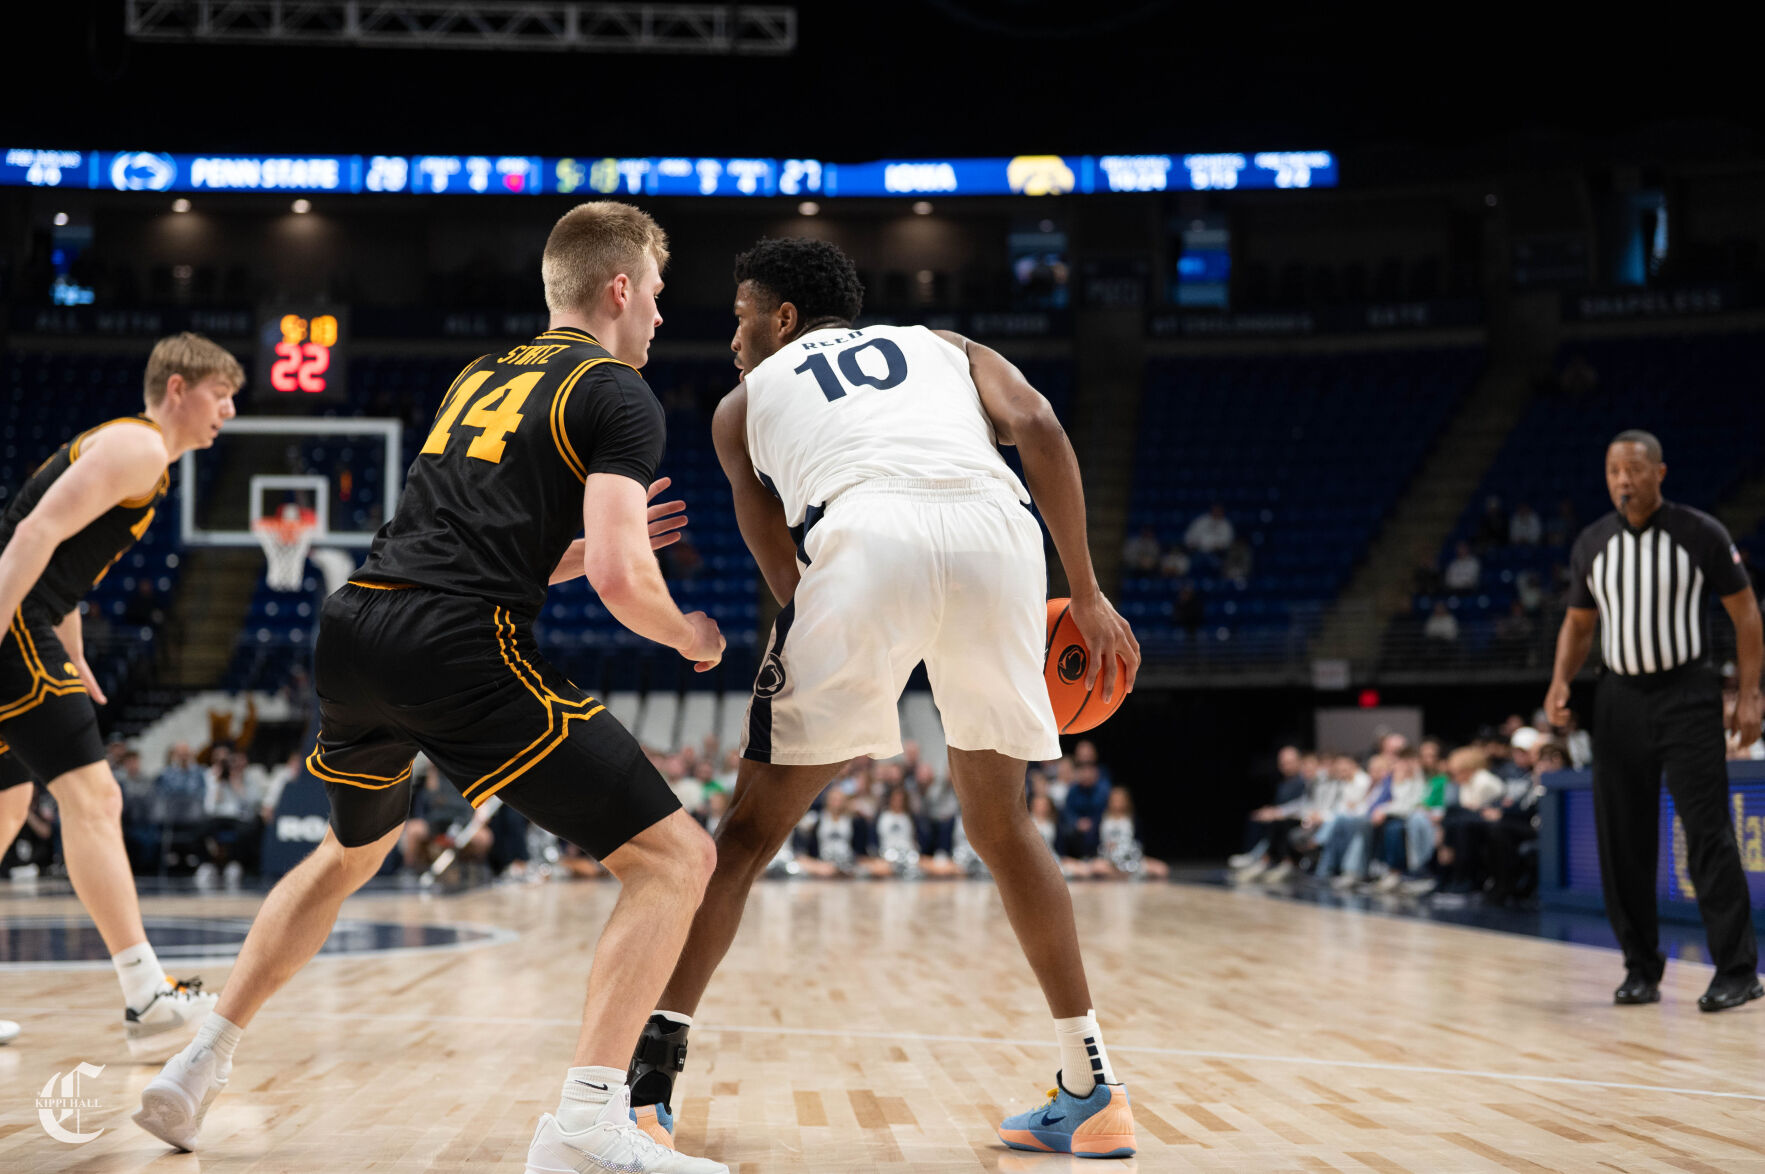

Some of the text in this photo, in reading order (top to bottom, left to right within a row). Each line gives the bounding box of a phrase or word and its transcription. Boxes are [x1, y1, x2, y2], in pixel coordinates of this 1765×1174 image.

[191, 158, 338, 188] PENN STATE
[885, 163, 957, 193] IOWA
[271, 342, 330, 392] 22
[793, 337, 907, 403] 10
[418, 370, 547, 464] 14
